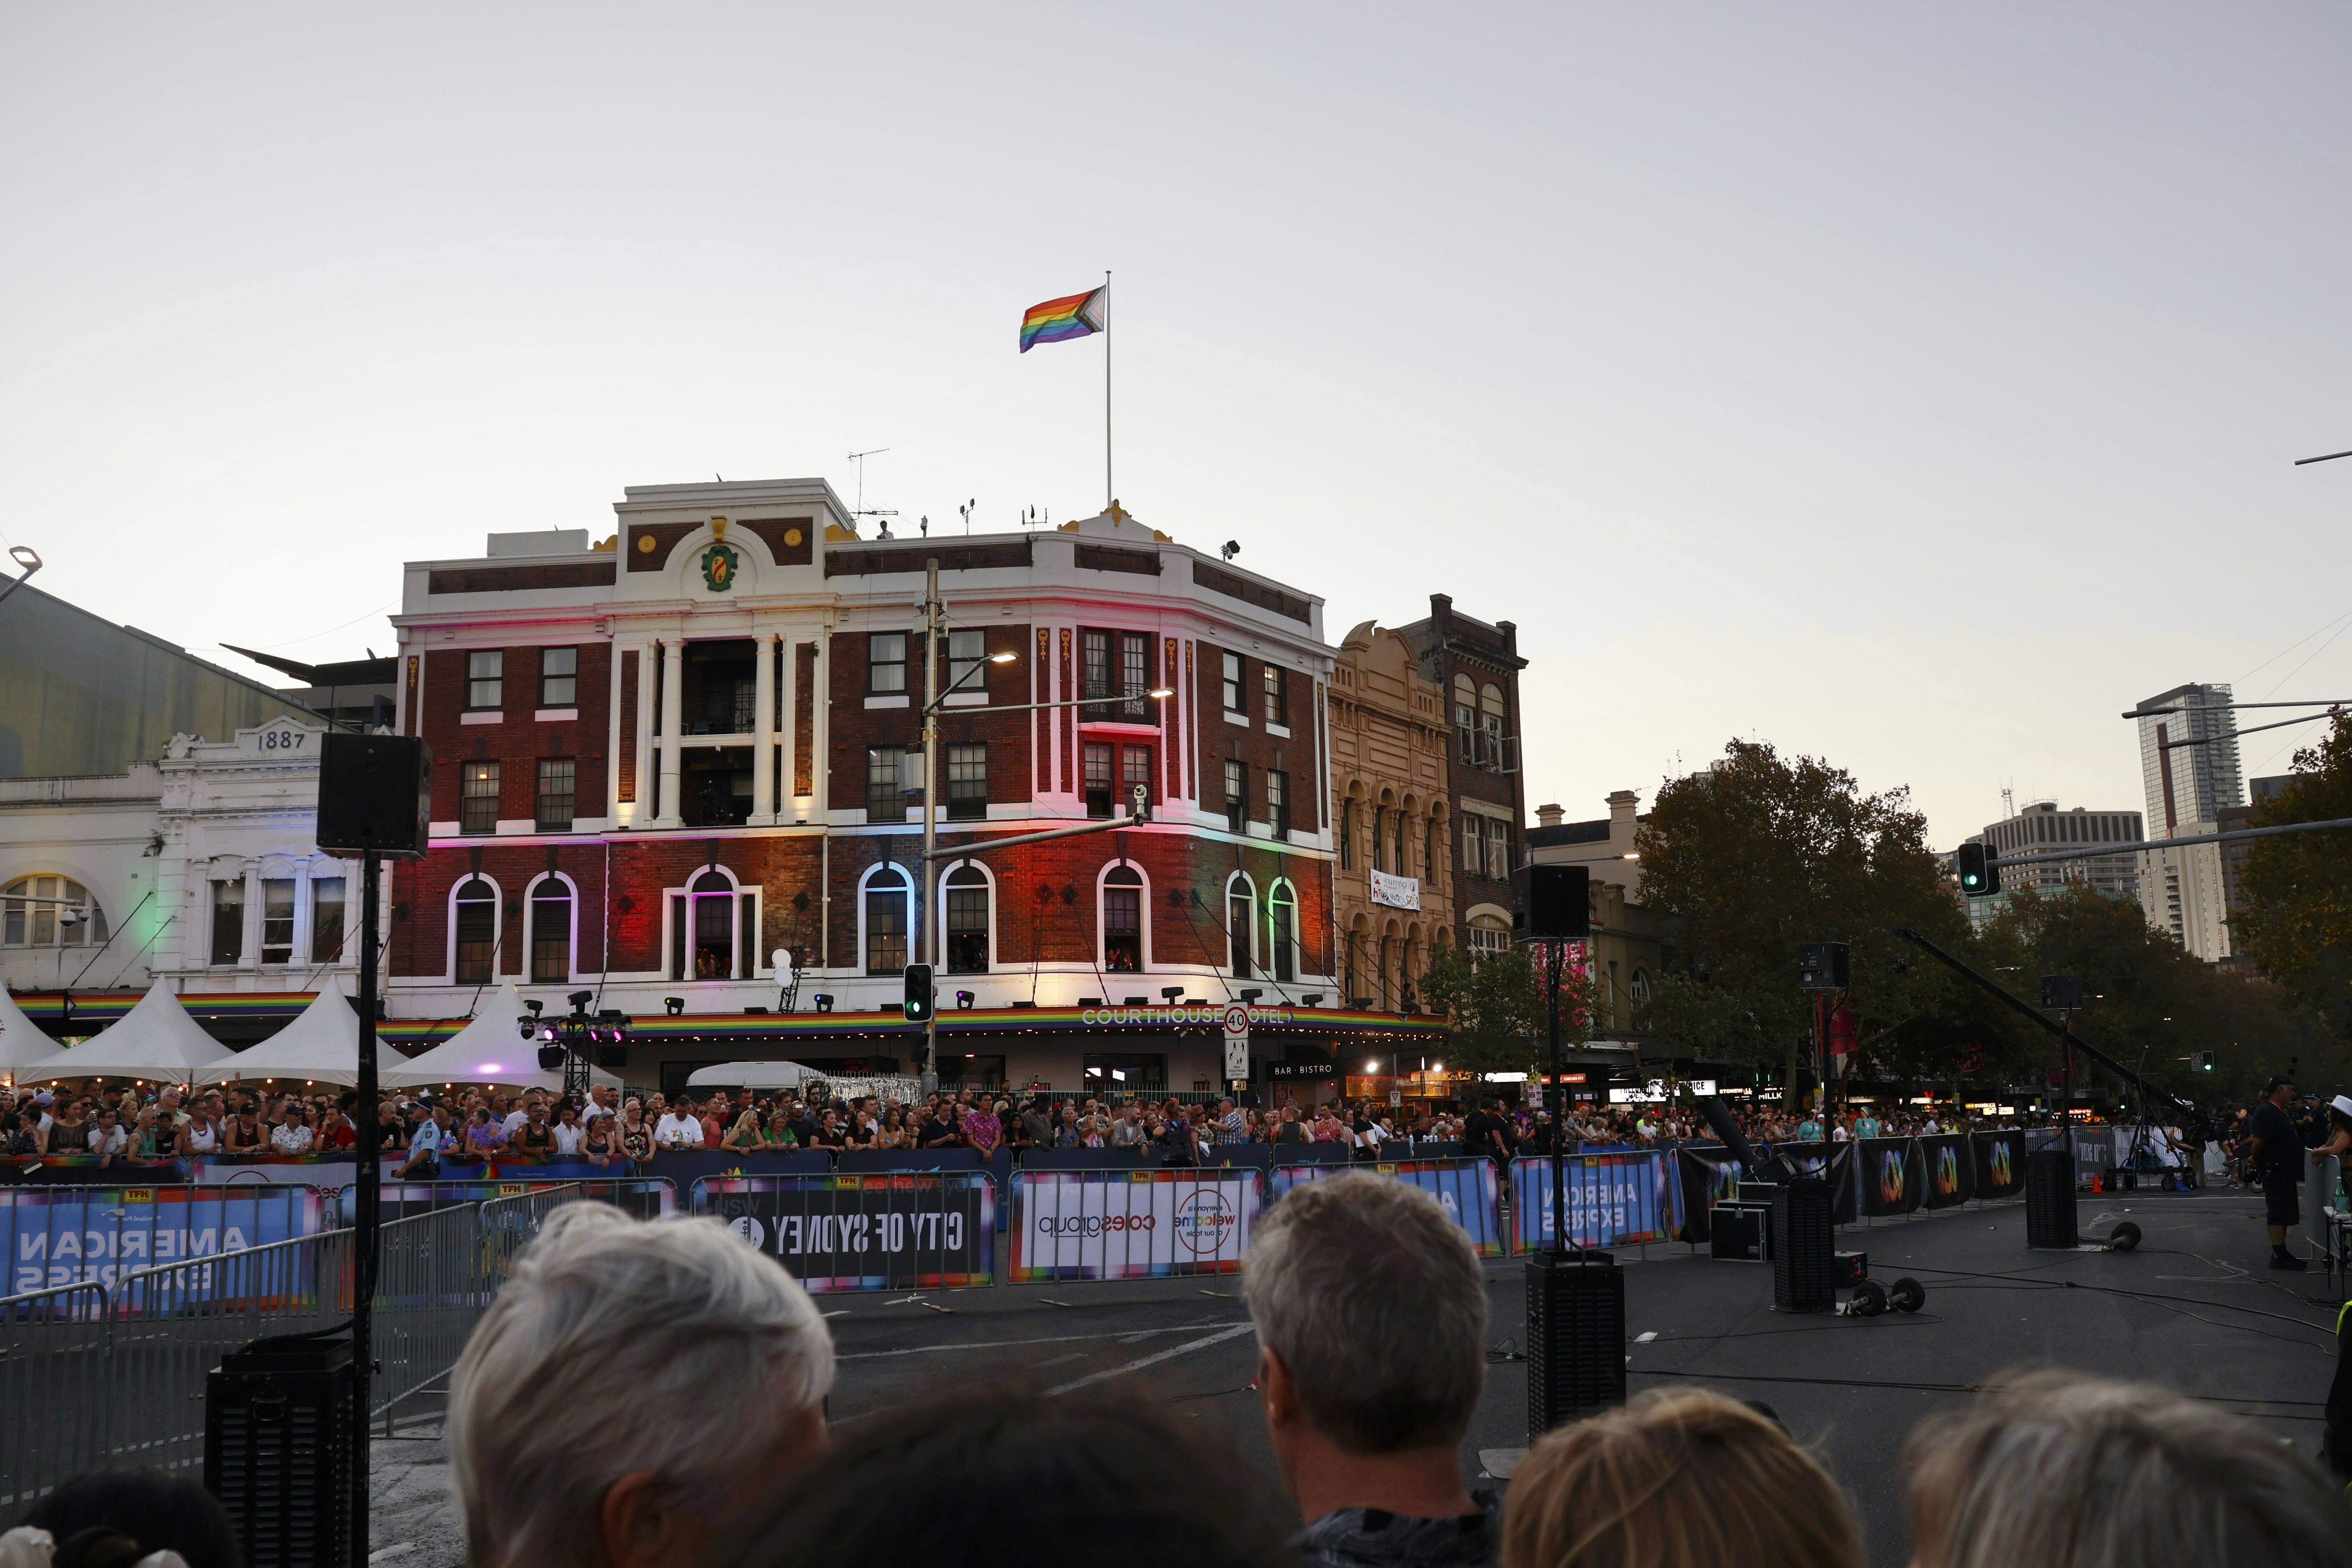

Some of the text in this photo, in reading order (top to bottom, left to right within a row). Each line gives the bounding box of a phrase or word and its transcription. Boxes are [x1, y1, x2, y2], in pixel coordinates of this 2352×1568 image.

[259, 731, 305, 750] 1887
[1082, 1008, 1284, 1024] COURTHOUSE OTEL
[1228, 1014, 1244, 1026] 40
[1300, 1065, 1332, 1074] BISTRO
[1276, 1090, 1285, 1098] $15
[715, 1199, 760, 1215] NSW
